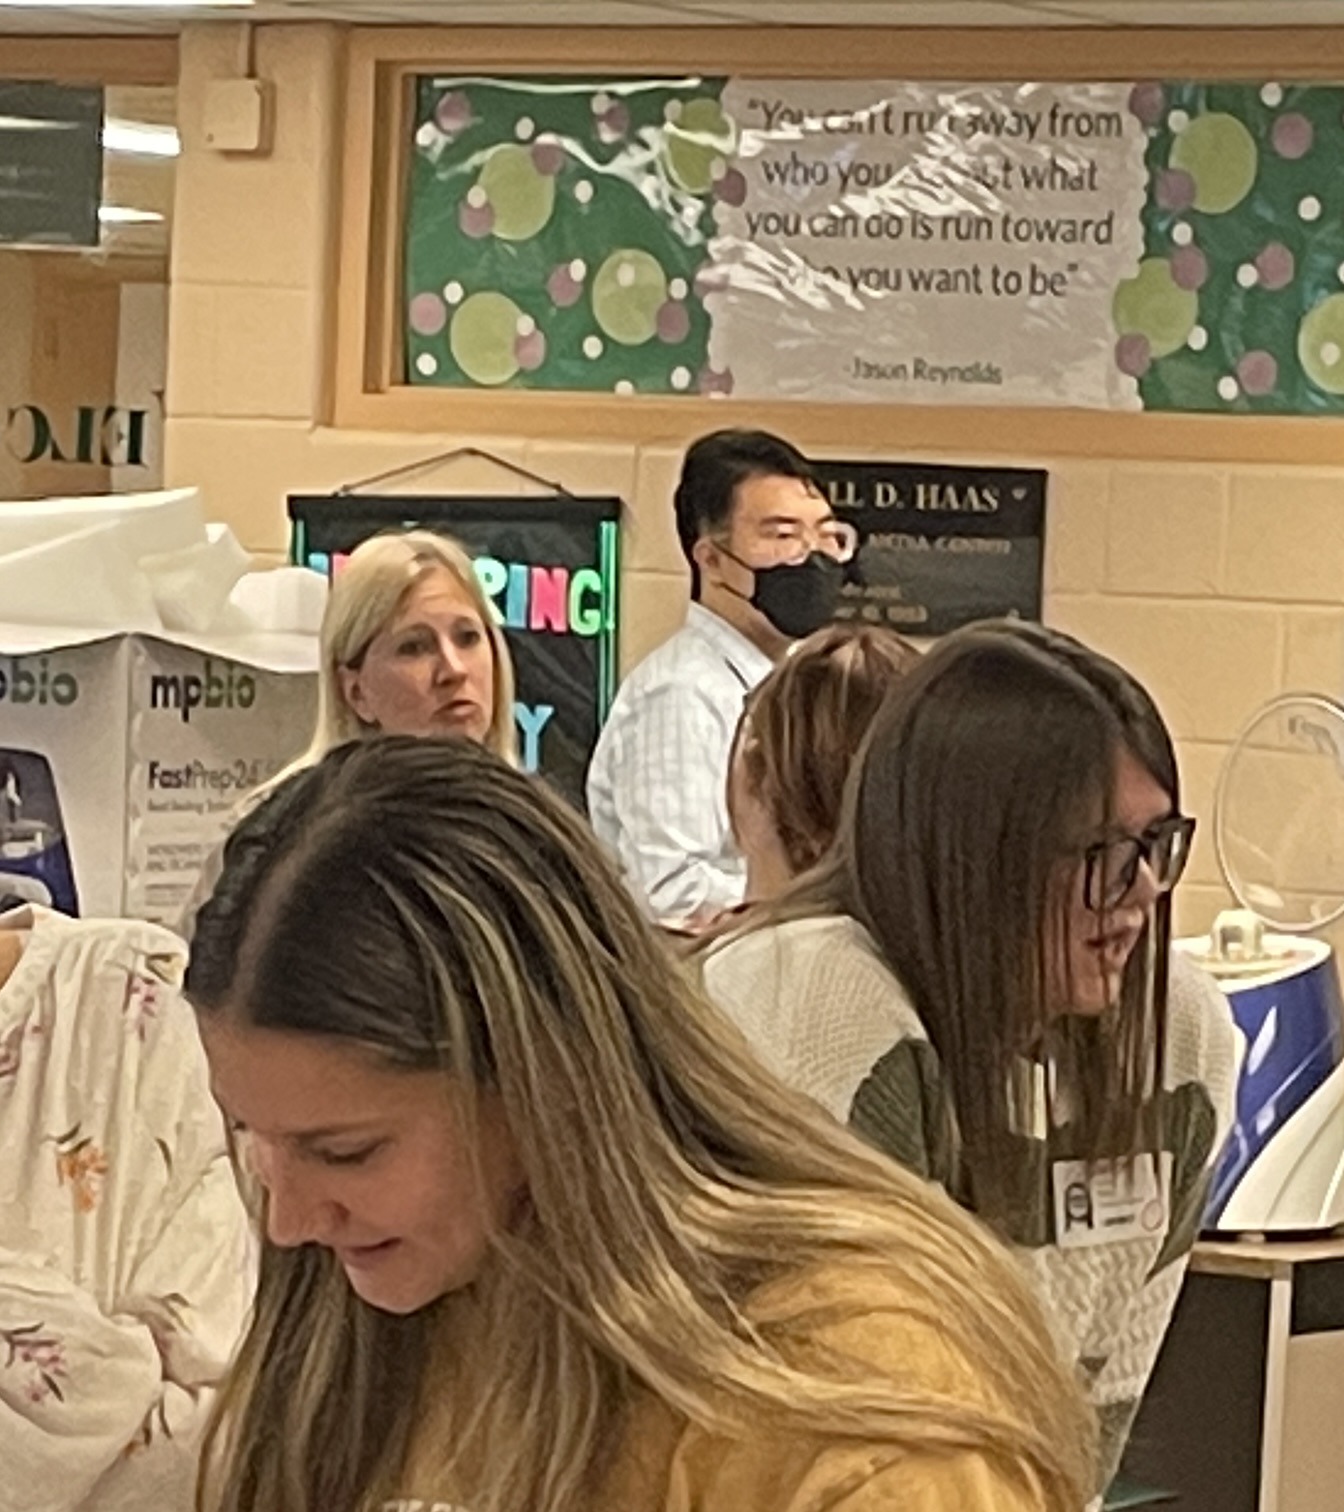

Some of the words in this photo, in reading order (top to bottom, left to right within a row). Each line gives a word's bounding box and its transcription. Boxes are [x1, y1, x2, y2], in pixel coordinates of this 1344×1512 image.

[823, 102, 894, 135] cant
[1050, 100, 1123, 138] from
[761, 150, 829, 186] who
[836, 160, 893, 193] you
[1020, 156, 1098, 191] what
[745, 212, 801, 241] you
[808, 212, 858, 238] can
[940, 214, 994, 241] run
[1001, 209, 1115, 245] toward
[846, 266, 902, 293] you
[908, 262, 983, 295] want
[991, 264, 1022, 296] to
[1028, 261, 1079, 297] be"
[913, 357, 1003, 386] Reynolds
[874, 481, 905, 510] D.
[914, 483, 1000, 513] HAAS
[150, 659, 256, 724] mpbio
